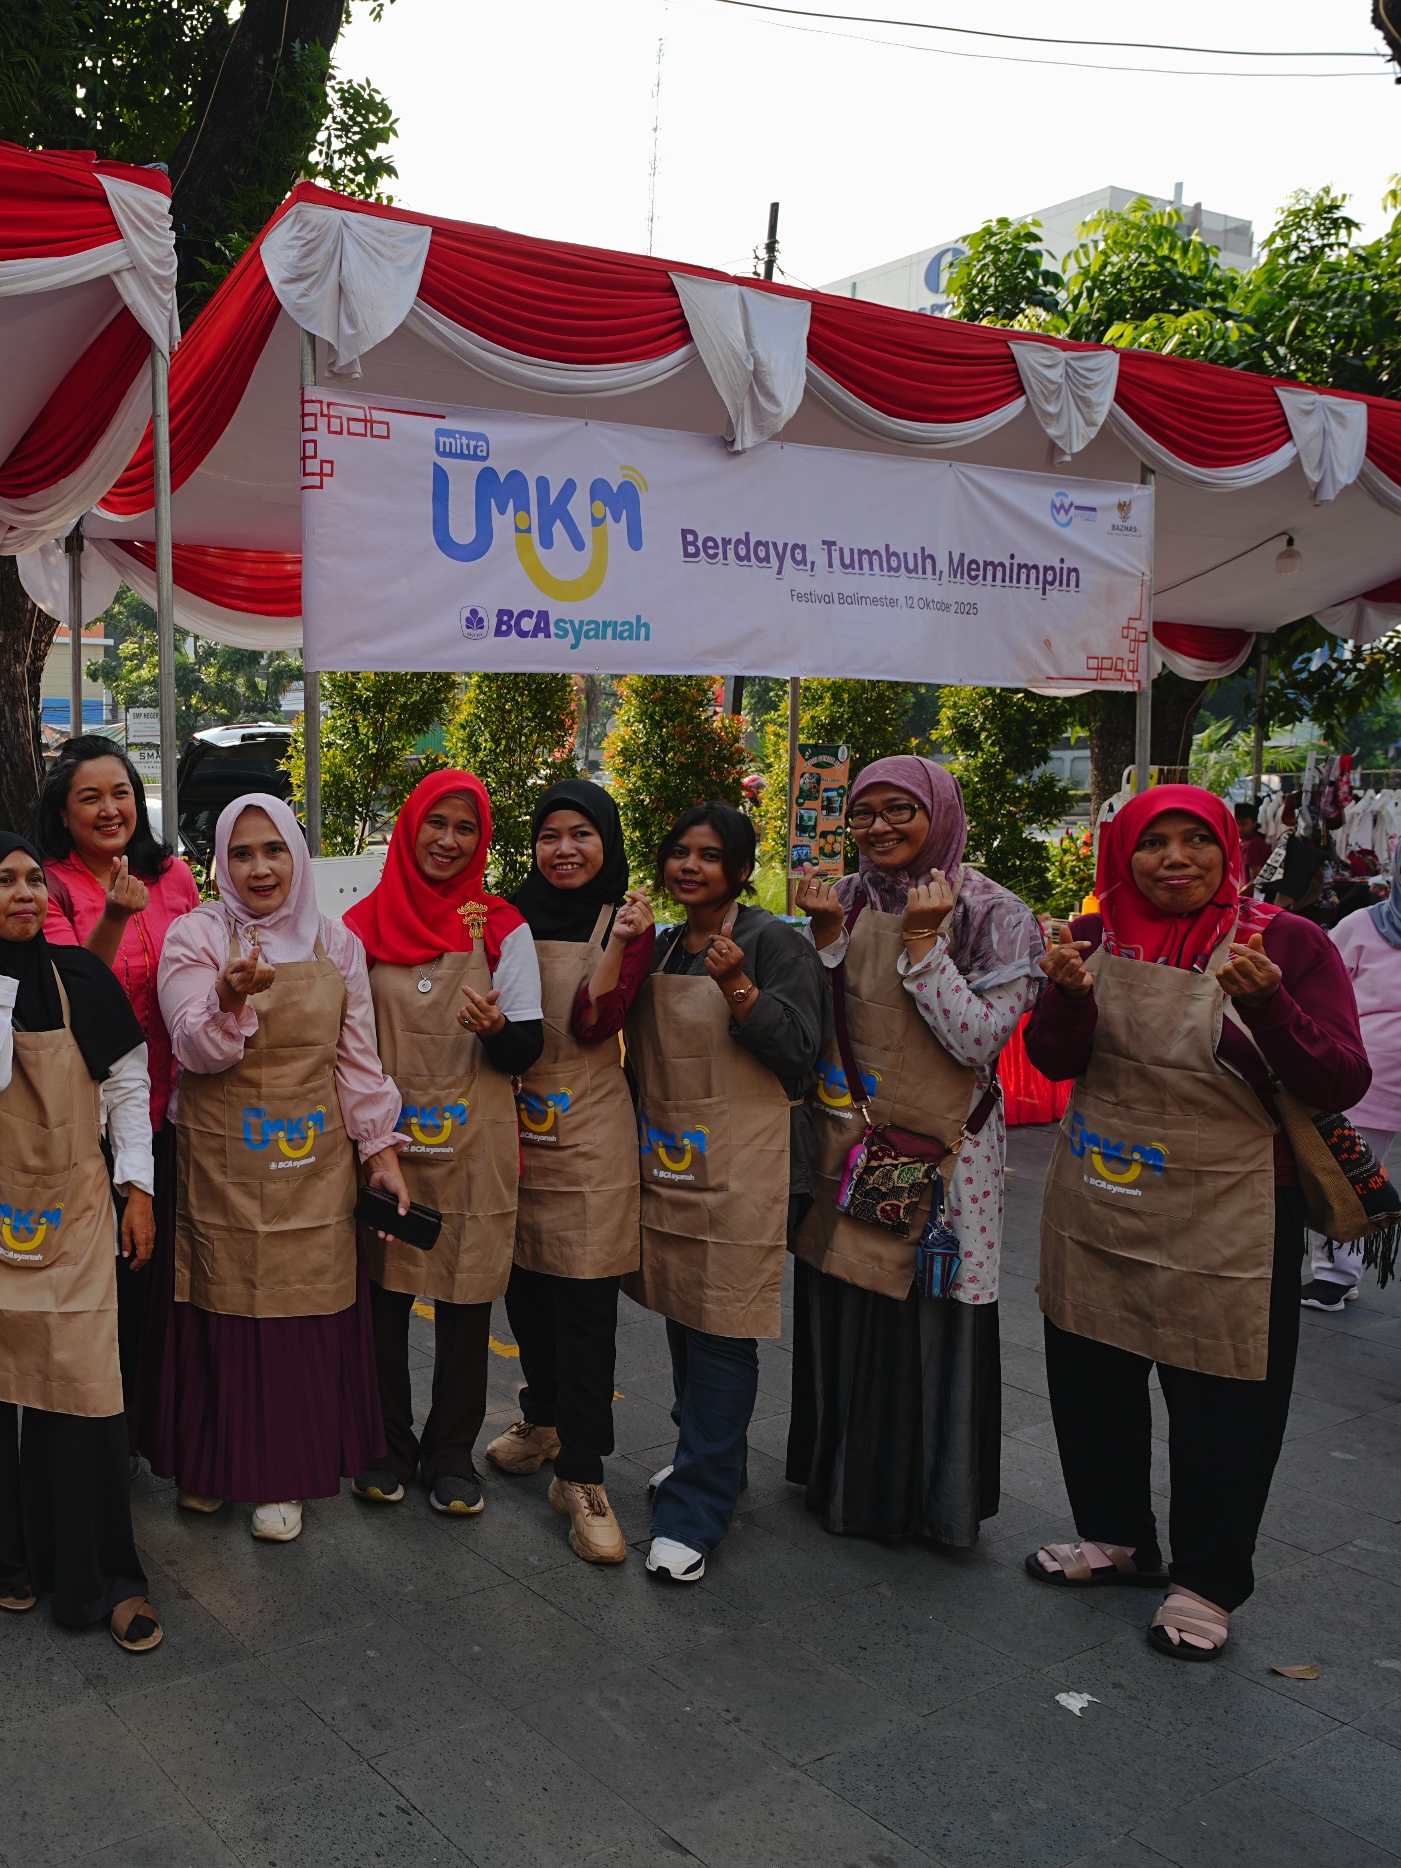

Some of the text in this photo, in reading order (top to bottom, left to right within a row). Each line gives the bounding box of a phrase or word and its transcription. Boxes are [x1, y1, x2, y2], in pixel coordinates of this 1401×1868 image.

[438, 433, 487, 457] mitra
[432, 461, 643, 566] UMKM
[1111, 524, 1137, 533] BAZNAS
[681, 528, 1080, 597] Berdaya, Tumbuh, Memimpin
[790, 589, 978, 615] Festival Balimester, 12 Oktober 2025
[243, 1110, 325, 1151] UMKM
[1069, 1123, 1165, 1177] UMKM
